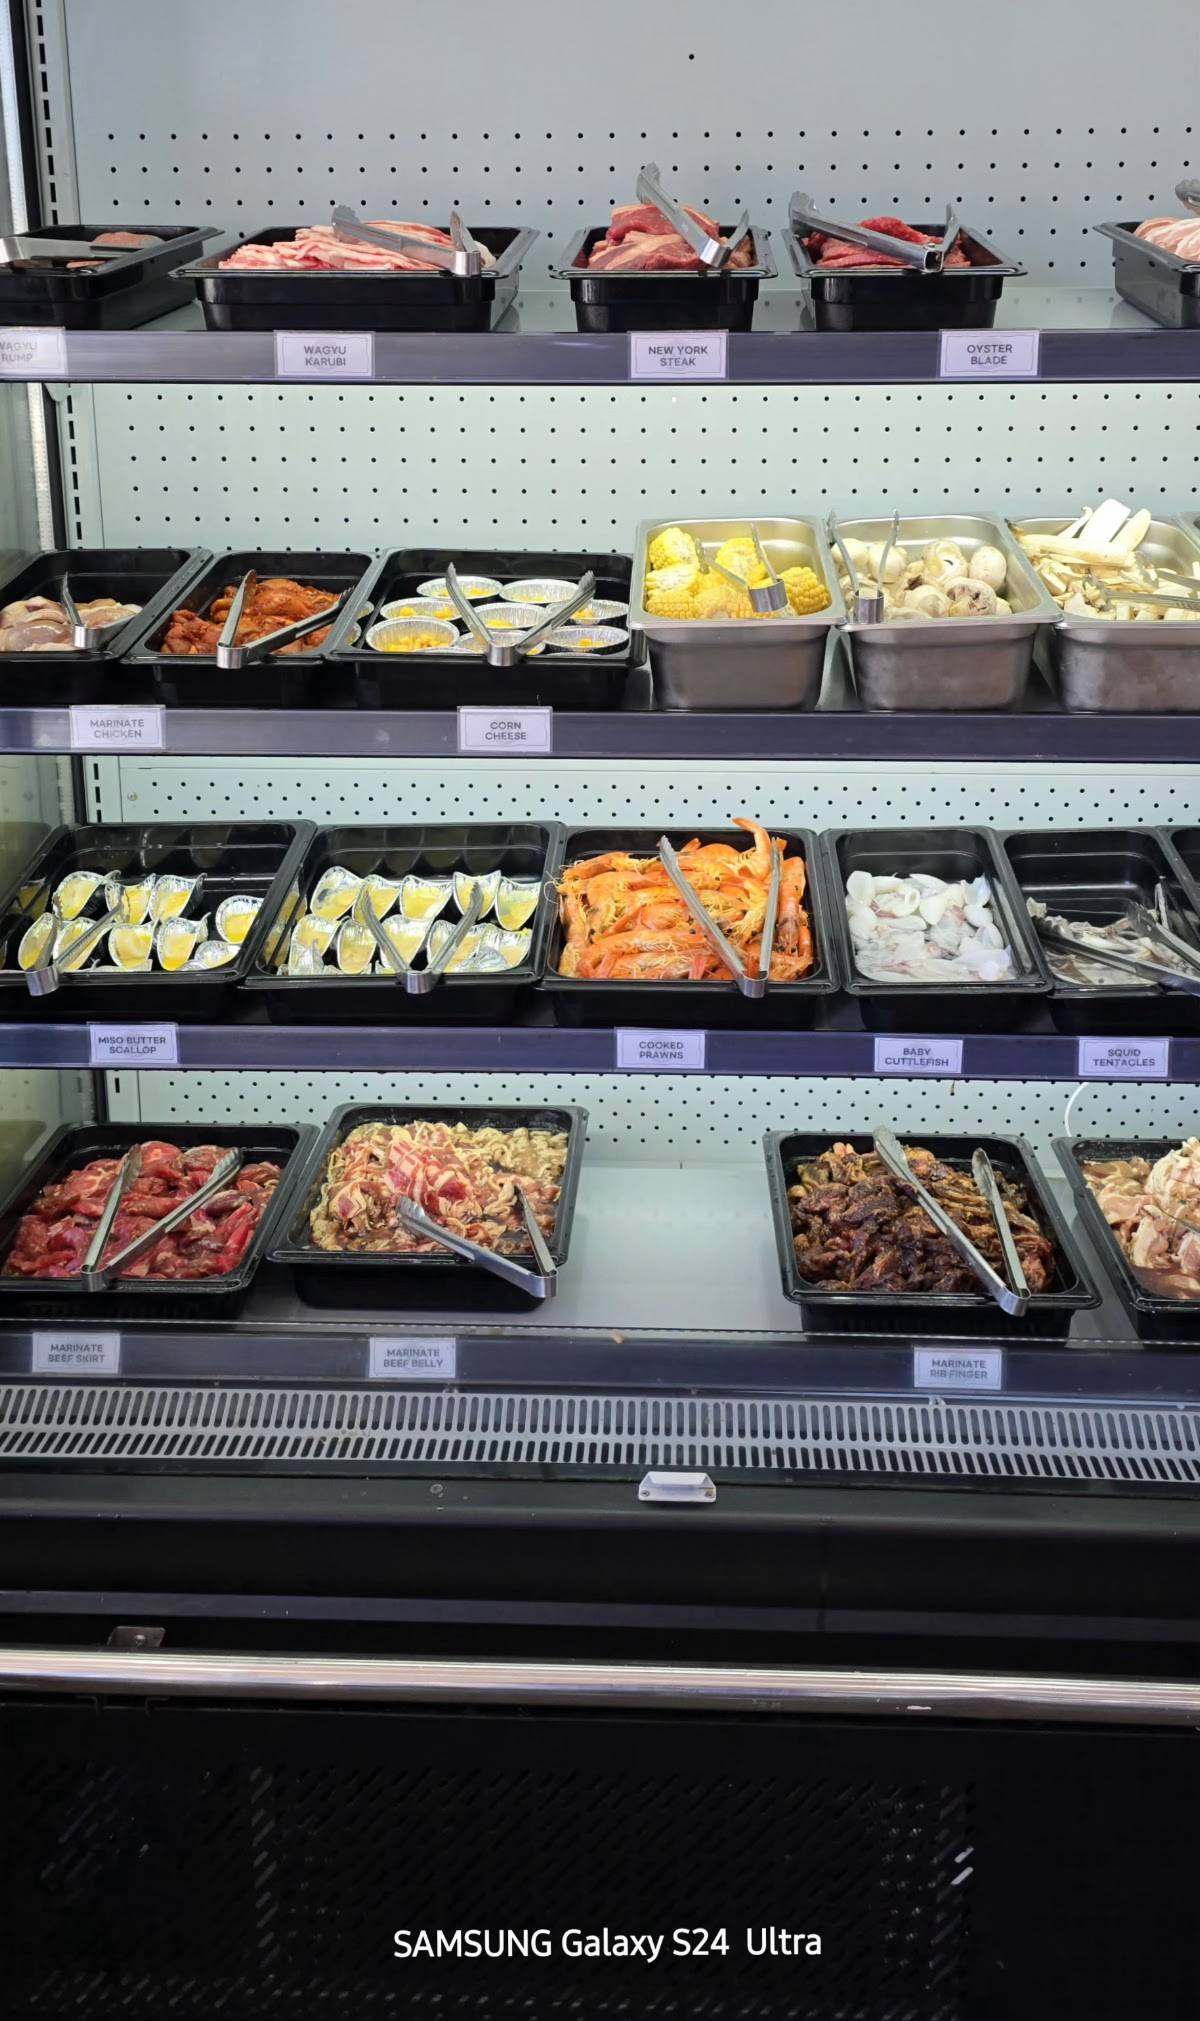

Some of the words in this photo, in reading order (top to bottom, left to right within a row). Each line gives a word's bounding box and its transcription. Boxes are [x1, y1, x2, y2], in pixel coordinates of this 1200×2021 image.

[303, 345, 347, 355] WAGYU
[648, 346, 674, 356] NEW
[677, 346, 708, 356] YORK
[966, 344, 1013, 354] OYSTER
[305, 357, 346, 367] KARUBI
[660, 357, 696, 367] STEAK
[970, 355, 1008, 366] BLADE
[90, 719, 145, 729] MARINATE
[490, 721, 522, 730] CORN
[94, 730, 142, 739] CHICKEN
[485, 731, 527, 741] CHEESE
[98, 1036, 124, 1046] MISO
[126, 1036, 167, 1046] BUTTER
[639, 1041, 684, 1050] COOKED
[109, 1046, 157, 1055] SCALLOP
[639, 1051, 684, 1060] PRAWNS
[902, 1047, 932, 1057] BABY
[1107, 1048, 1142, 1058] SQUID
[884, 1057, 950, 1067] CUTTLEFISH
[1092, 1058, 1157, 1068] TENTACLES
[50, 1344, 104, 1353] MARINATE
[387, 1348, 440, 1358] MARINATE
[48, 1354, 73, 1364] BEEF
[75, 1354, 105, 1364] SKIRT
[383, 1358, 409, 1368] BEEF
[411, 1358, 444, 1368] BELLY
[932, 1360, 986, 1369] MARINATE
[930, 1369, 947, 1378] RIB
[949, 1370, 988, 1380] FINGER
